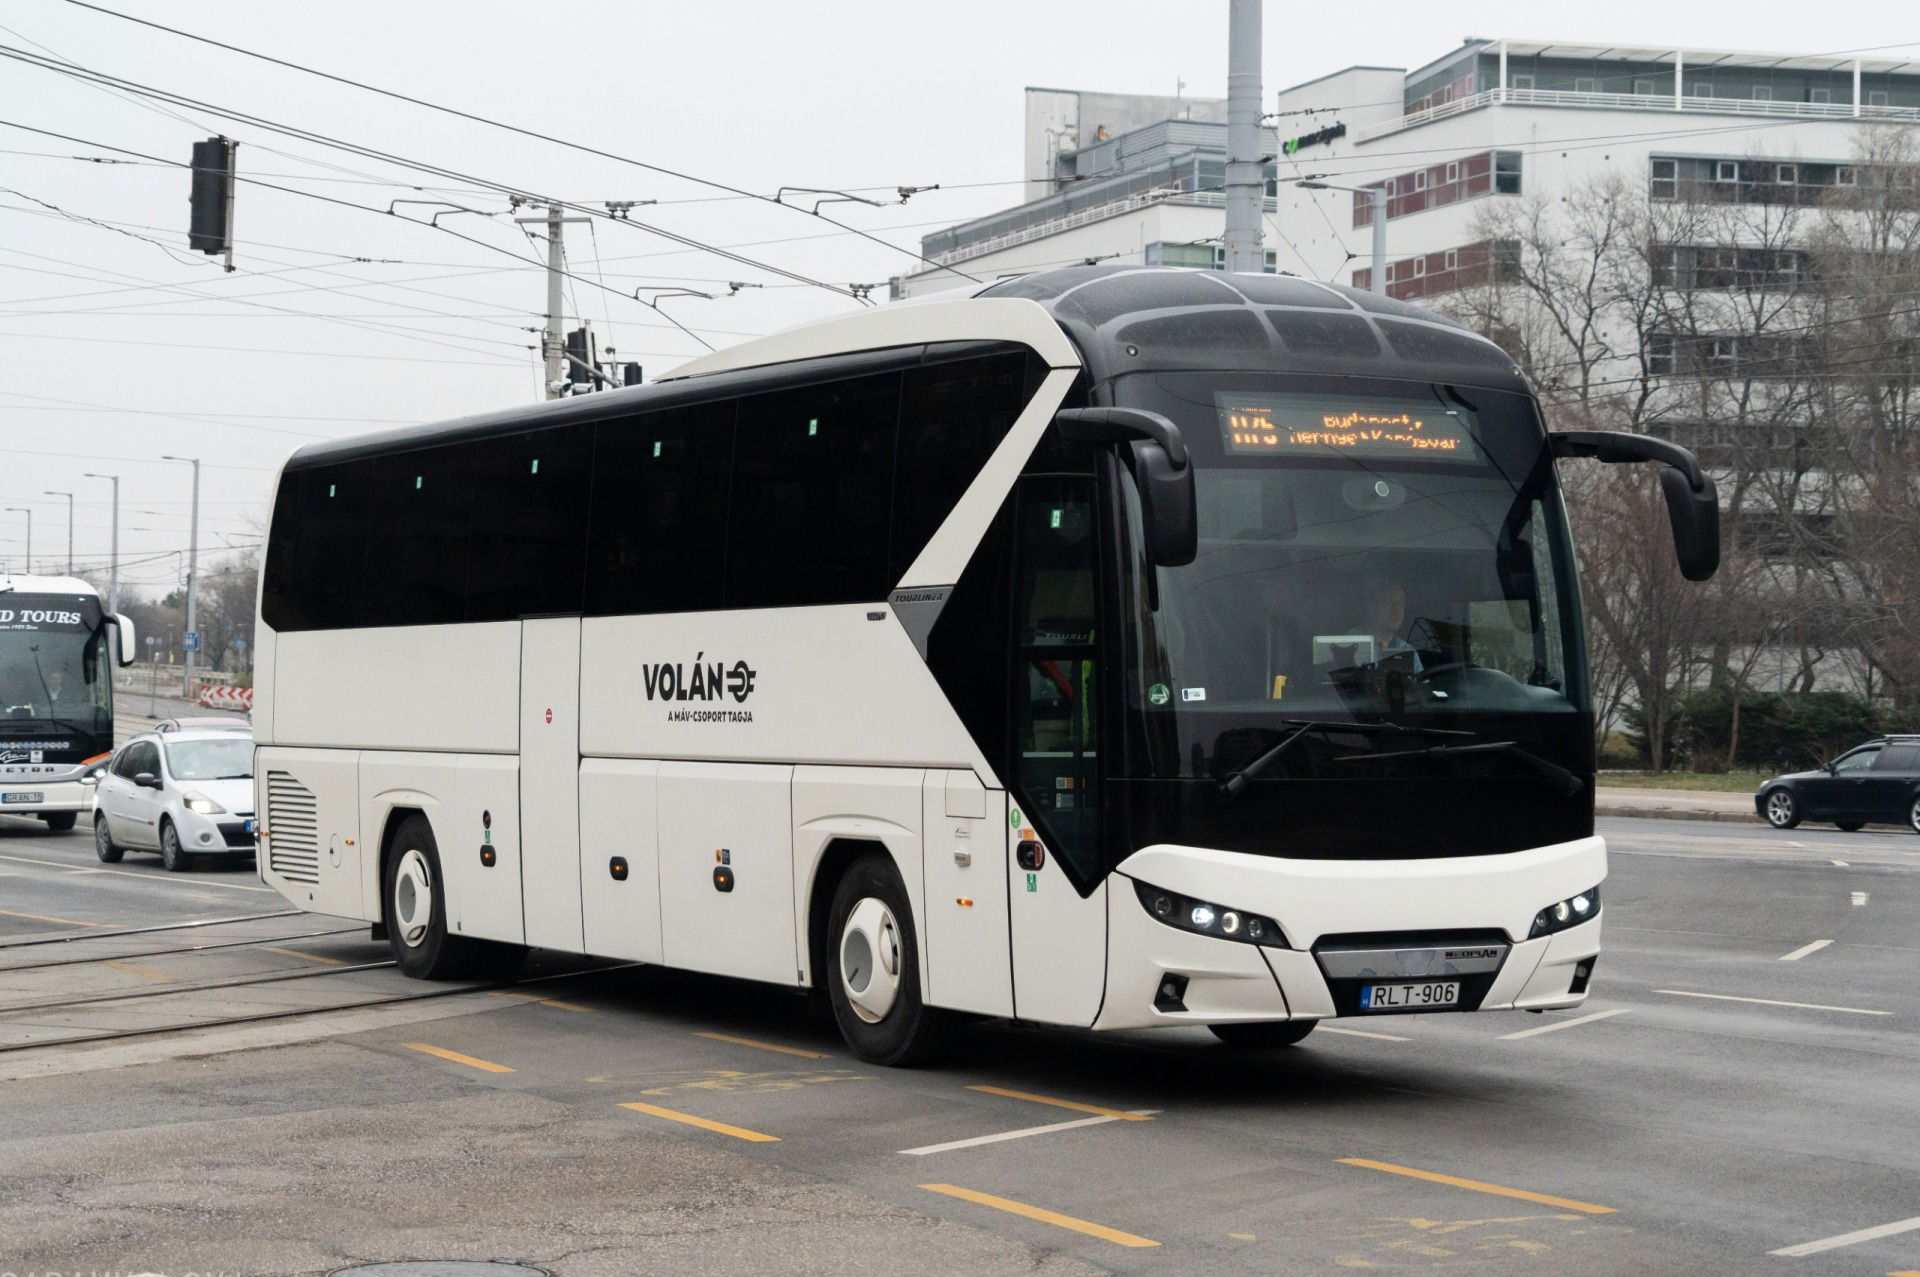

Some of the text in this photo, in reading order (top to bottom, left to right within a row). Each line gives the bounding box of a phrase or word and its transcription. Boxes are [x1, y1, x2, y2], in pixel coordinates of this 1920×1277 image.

[895, 593, 943, 602] TOURLINER
[20, 610, 81, 624] TOURS
[642, 652, 723, 701] VOLÁN
[668, 708, 753, 722] A MÁV-CSOPORT TAGJA
[1374, 984, 1455, 1006] RLT-906
